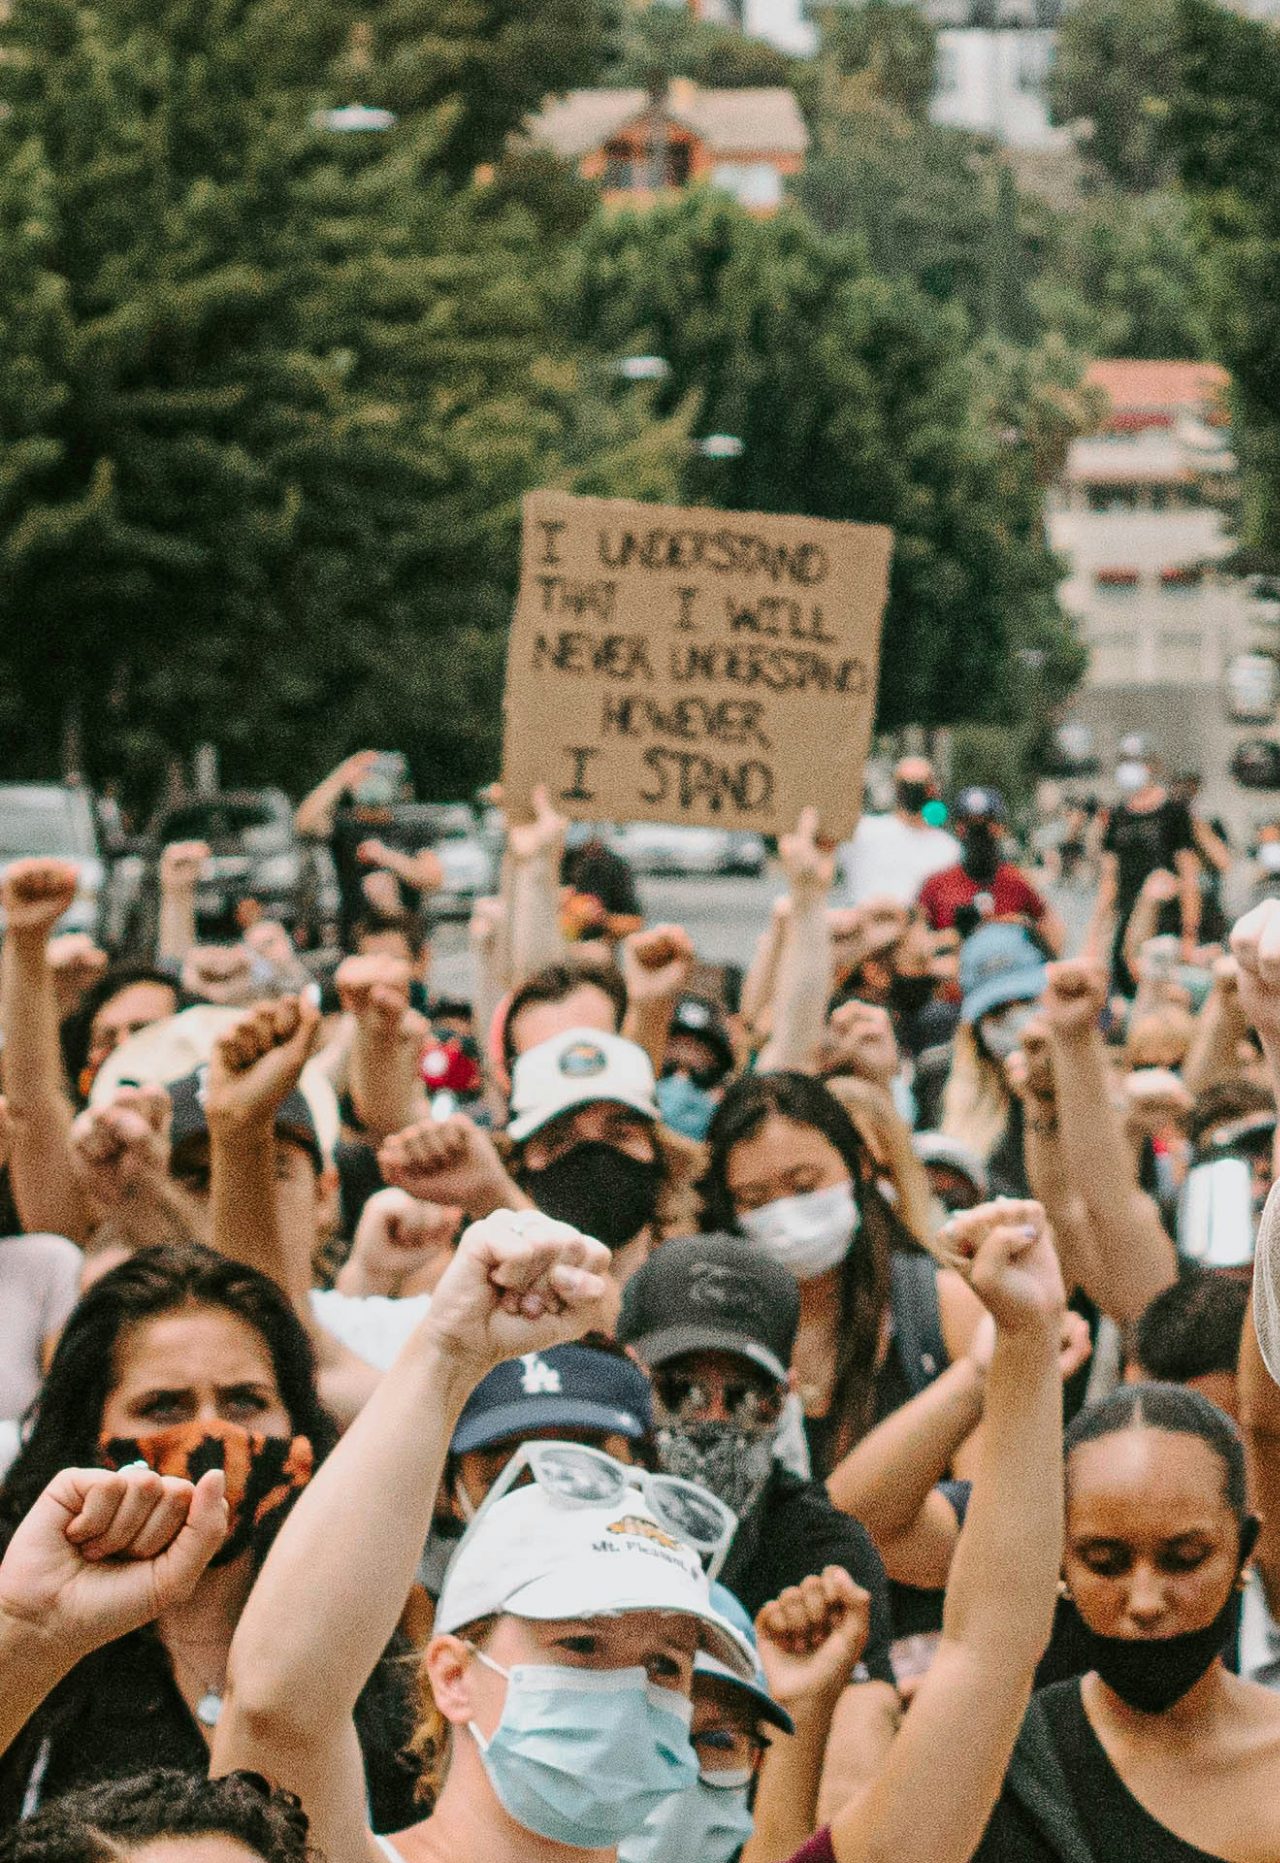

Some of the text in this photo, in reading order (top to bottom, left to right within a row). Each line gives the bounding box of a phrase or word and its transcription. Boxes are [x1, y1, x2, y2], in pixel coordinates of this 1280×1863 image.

[537, 519, 829, 588] I UNDERSTAND
[536, 575, 837, 646] THAT I WILL
[531, 629, 867, 697] NEVER UNDERSTAND
[602, 690, 770, 751] HOWEVER
[560, 744, 775, 814] I STAND
